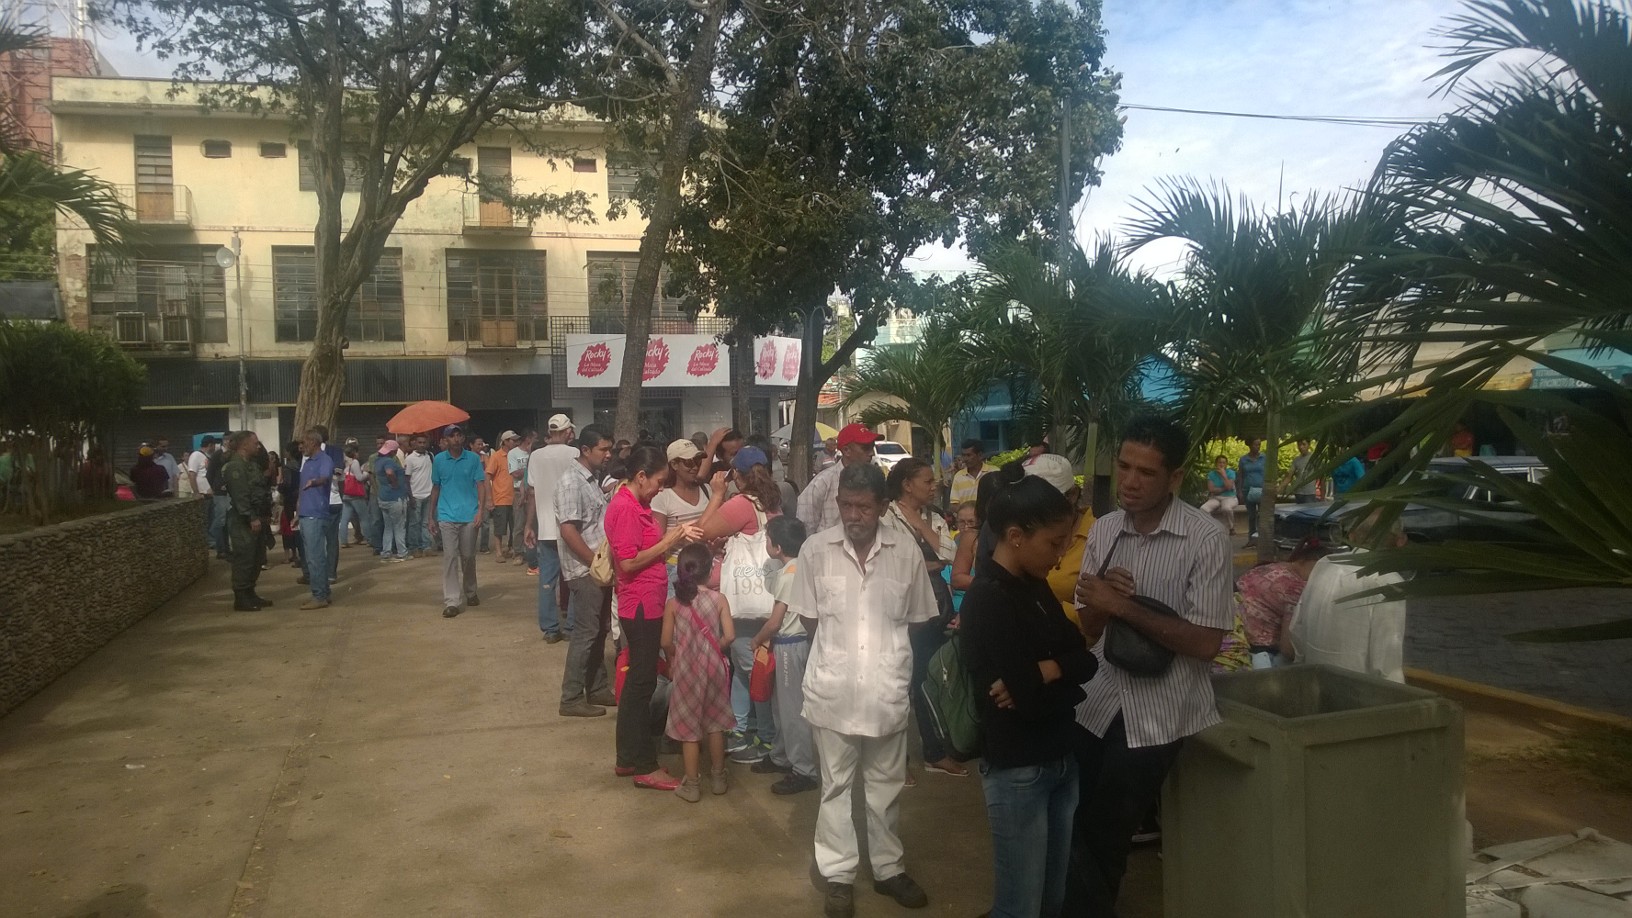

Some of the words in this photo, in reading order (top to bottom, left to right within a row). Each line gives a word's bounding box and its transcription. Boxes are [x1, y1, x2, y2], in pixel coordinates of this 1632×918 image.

[584, 348, 607, 361] Rocky
[694, 348, 714, 361] Rocky
[732, 577, 764, 596] 198
